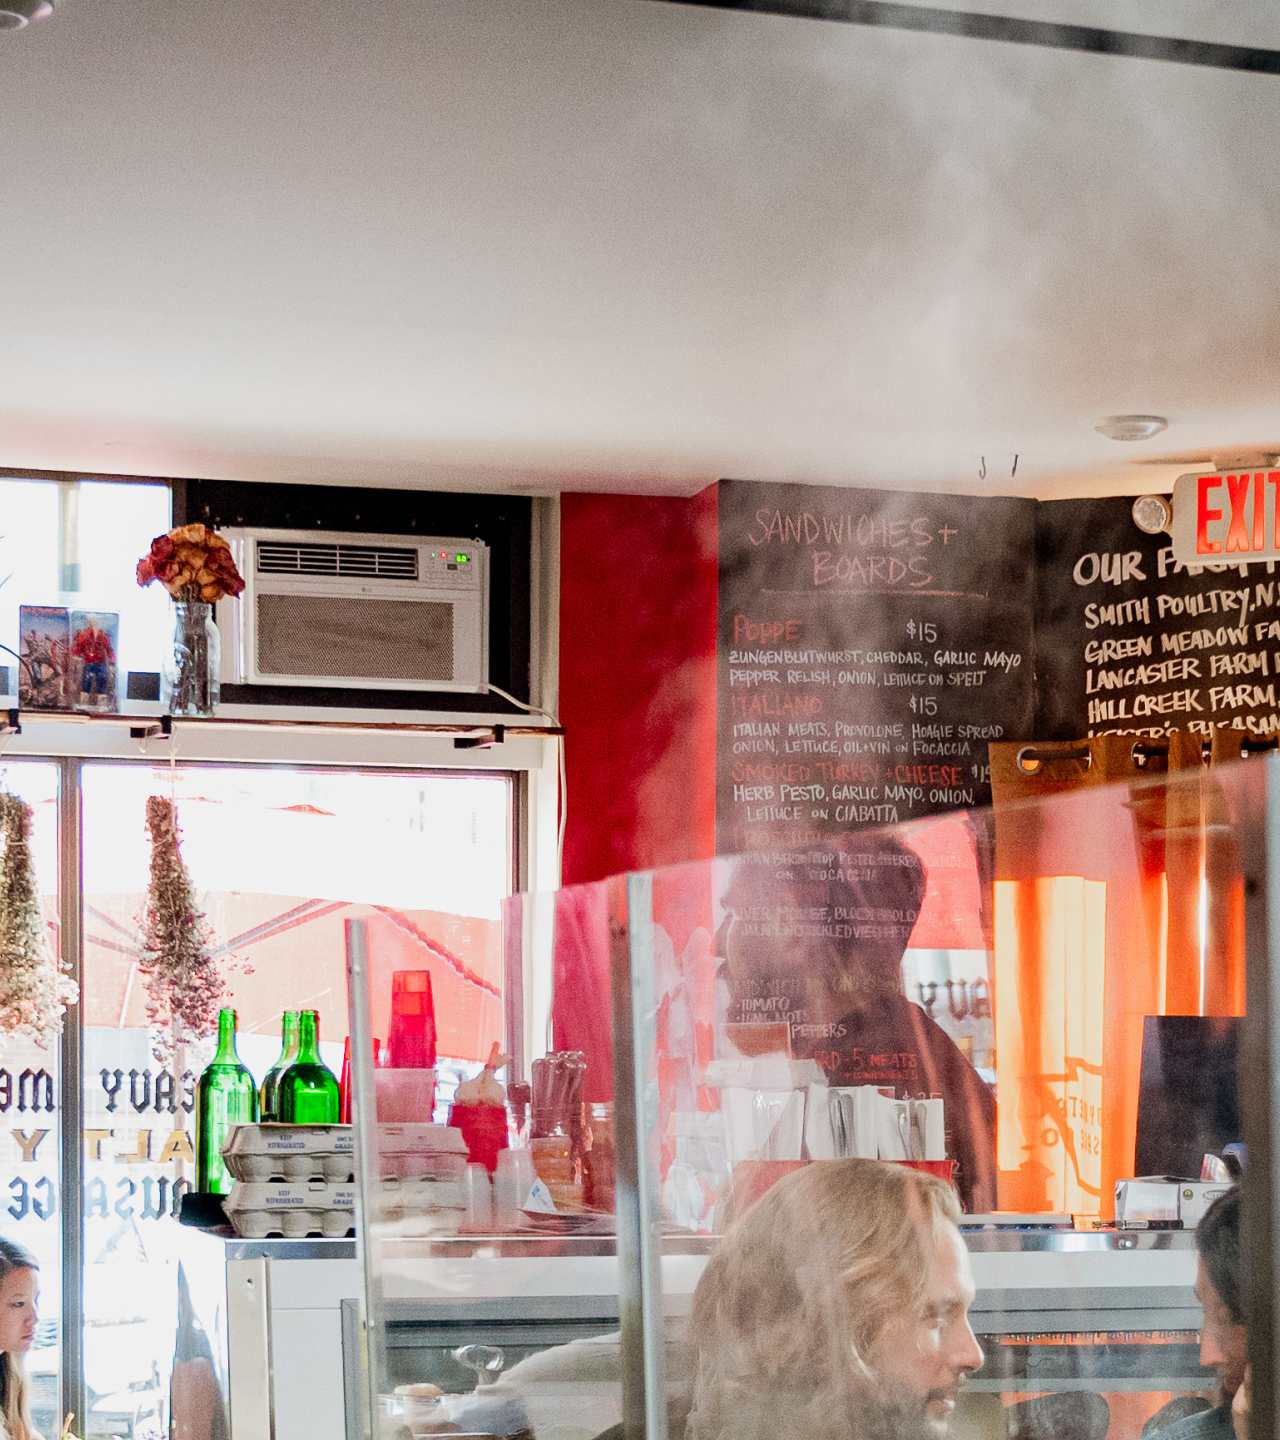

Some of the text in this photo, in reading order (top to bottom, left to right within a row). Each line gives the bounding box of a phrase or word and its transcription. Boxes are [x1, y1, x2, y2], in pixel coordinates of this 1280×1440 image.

[745, 508, 933, 547] SANDWICHES
[812, 550, 936, 587] BOARDS
[1073, 551, 1147, 586] OUR
[1085, 597, 1151, 629] SMITH
[906, 618, 937, 643] $15
[1084, 636, 1153, 665] GREEN
[1161, 624, 1250, 656] MEADOW
[934, 650, 977, 667] GARLIC
[983, 651, 1022, 674] MAYO
[1086, 658, 1202, 694] LANCASTER
[1210, 650, 1269, 677] FARM
[730, 669, 781, 688] PEPPER
[909, 694, 938, 716] $15
[733, 722, 780, 737] ITALIAN
[912, 723, 953, 740] HOAGIE
[958, 724, 1004, 739] SPREAD
[913, 740, 971, 756] FOCACCIA
[733, 784, 775, 802] HERB
[832, 785, 880, 801] GARLIC
[835, 804, 898, 823] CIABATTA
